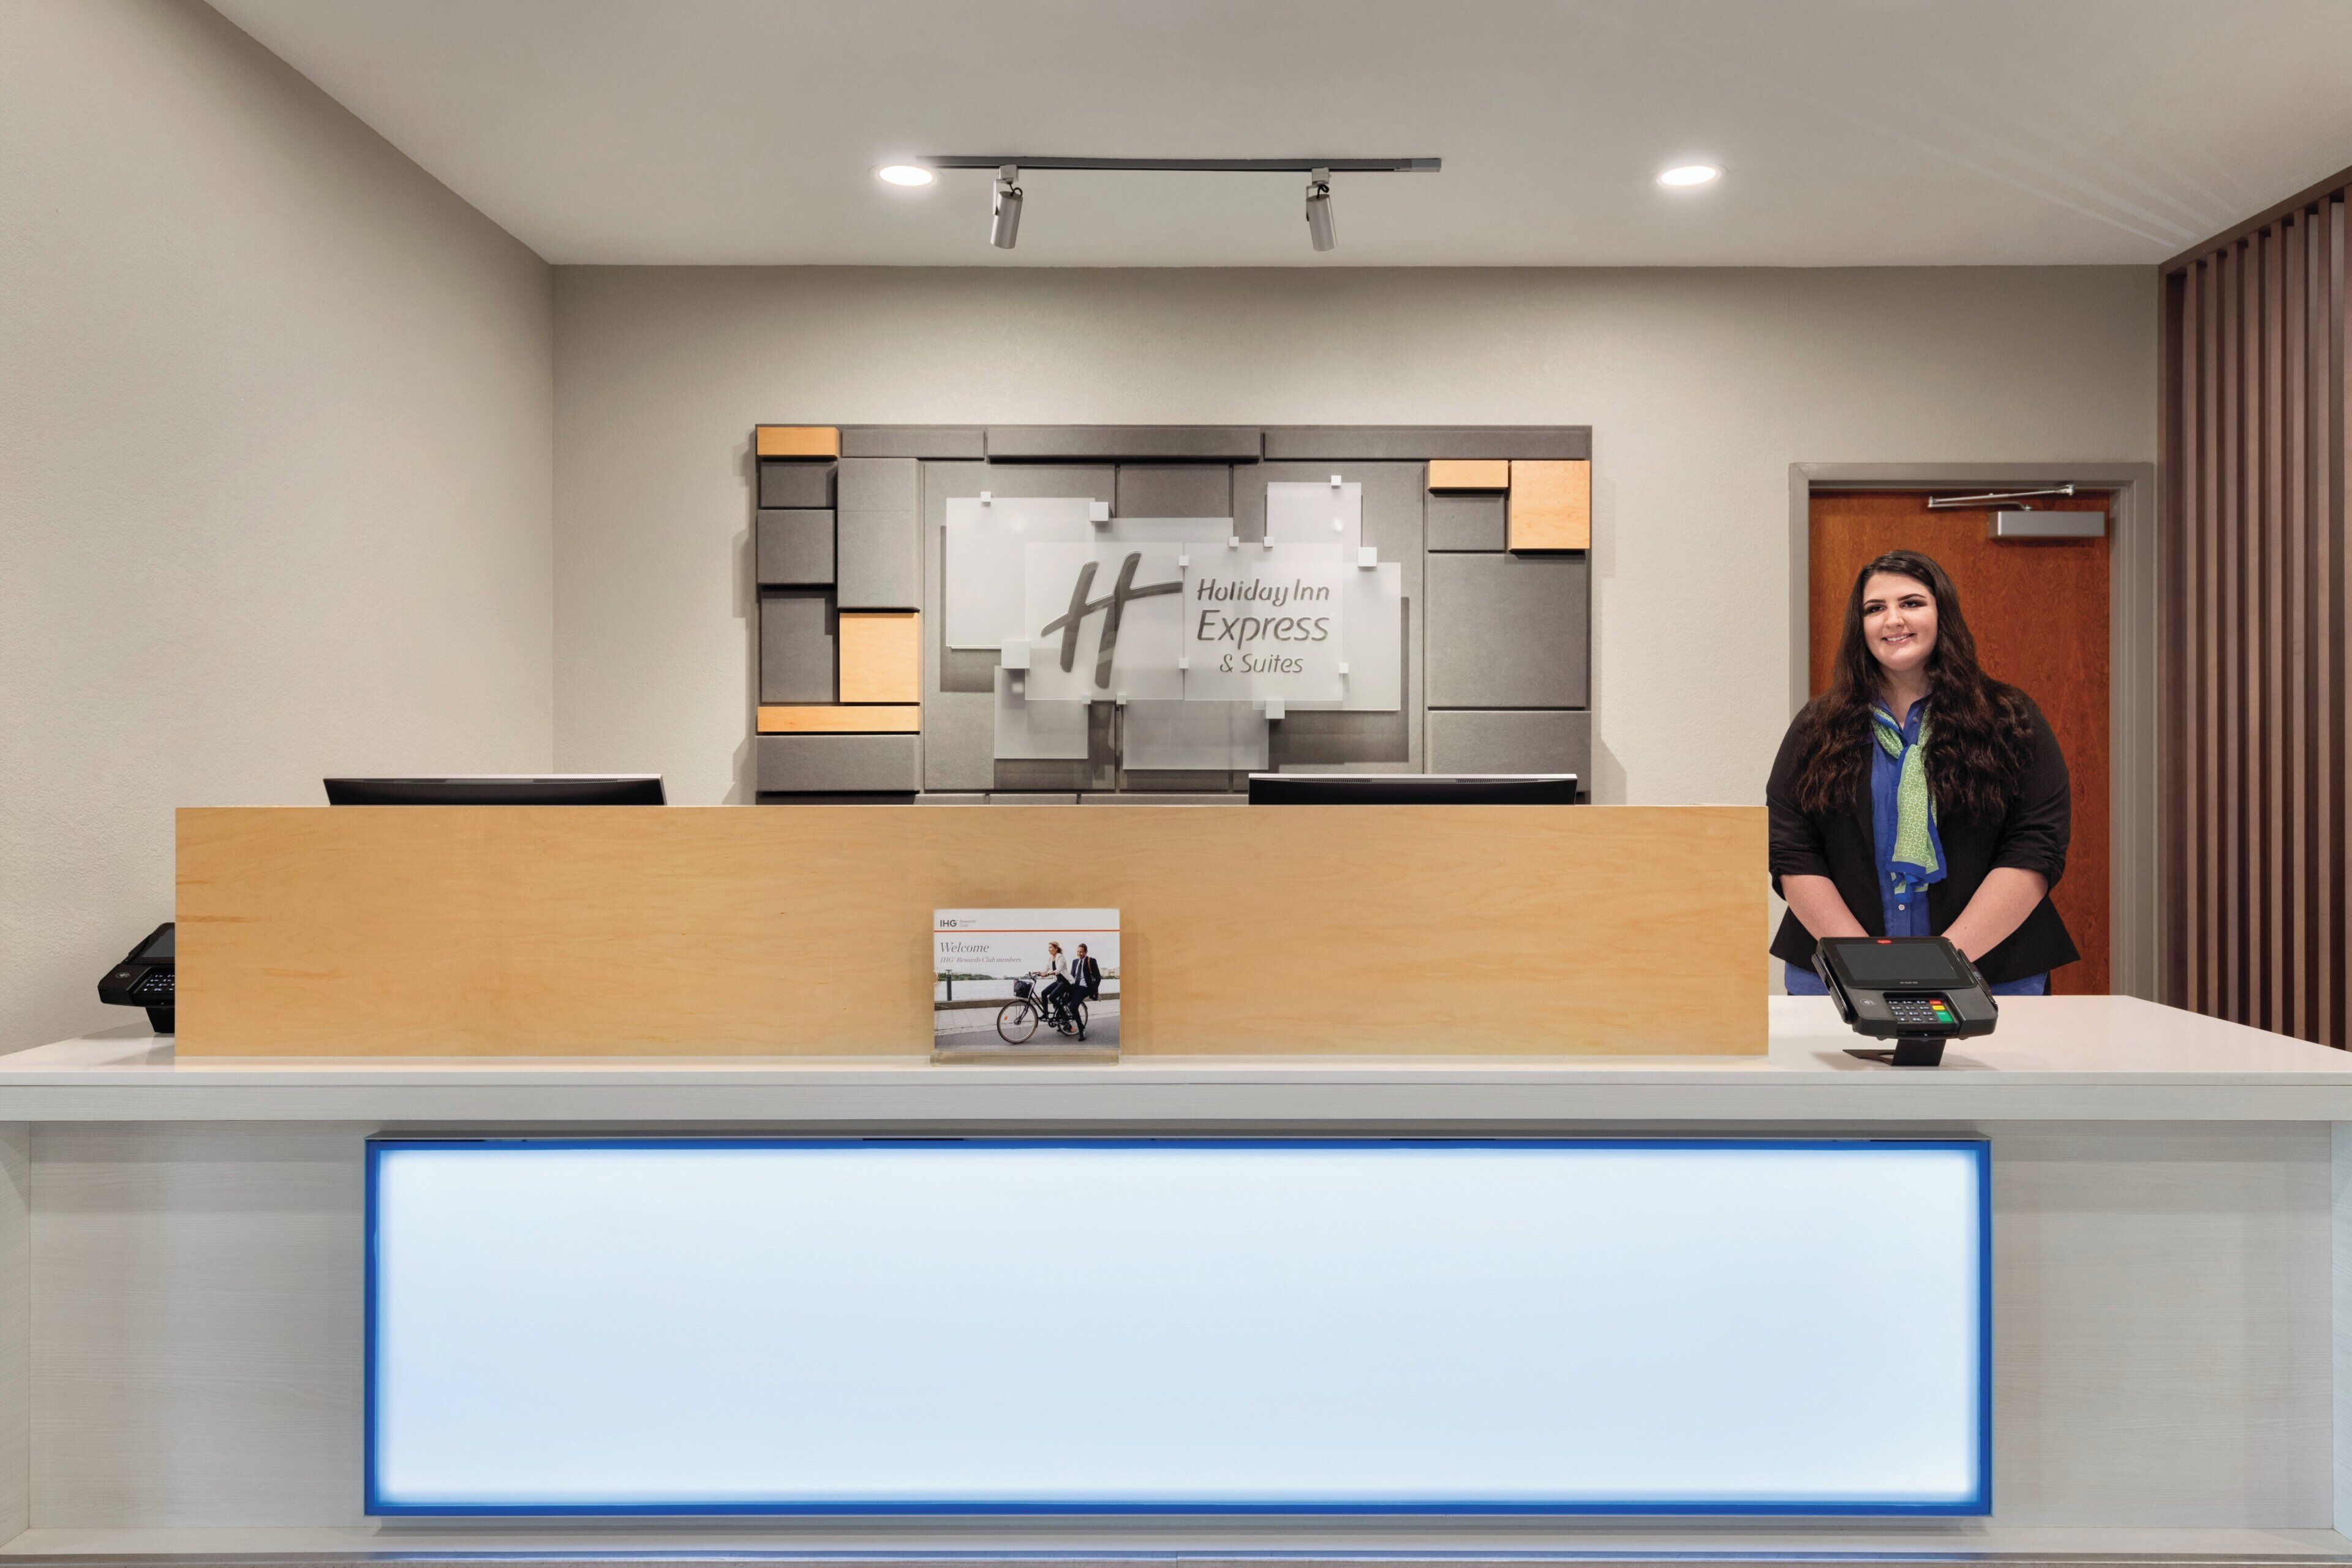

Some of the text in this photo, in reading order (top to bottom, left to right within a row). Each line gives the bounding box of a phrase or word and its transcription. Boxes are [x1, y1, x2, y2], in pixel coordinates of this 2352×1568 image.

[1197, 578, 1330, 606] Holiday Inn
[1197, 609, 1330, 650] Express
[1220, 653, 1303, 673] & Suites
[940, 941, 989, 953] Welcome
